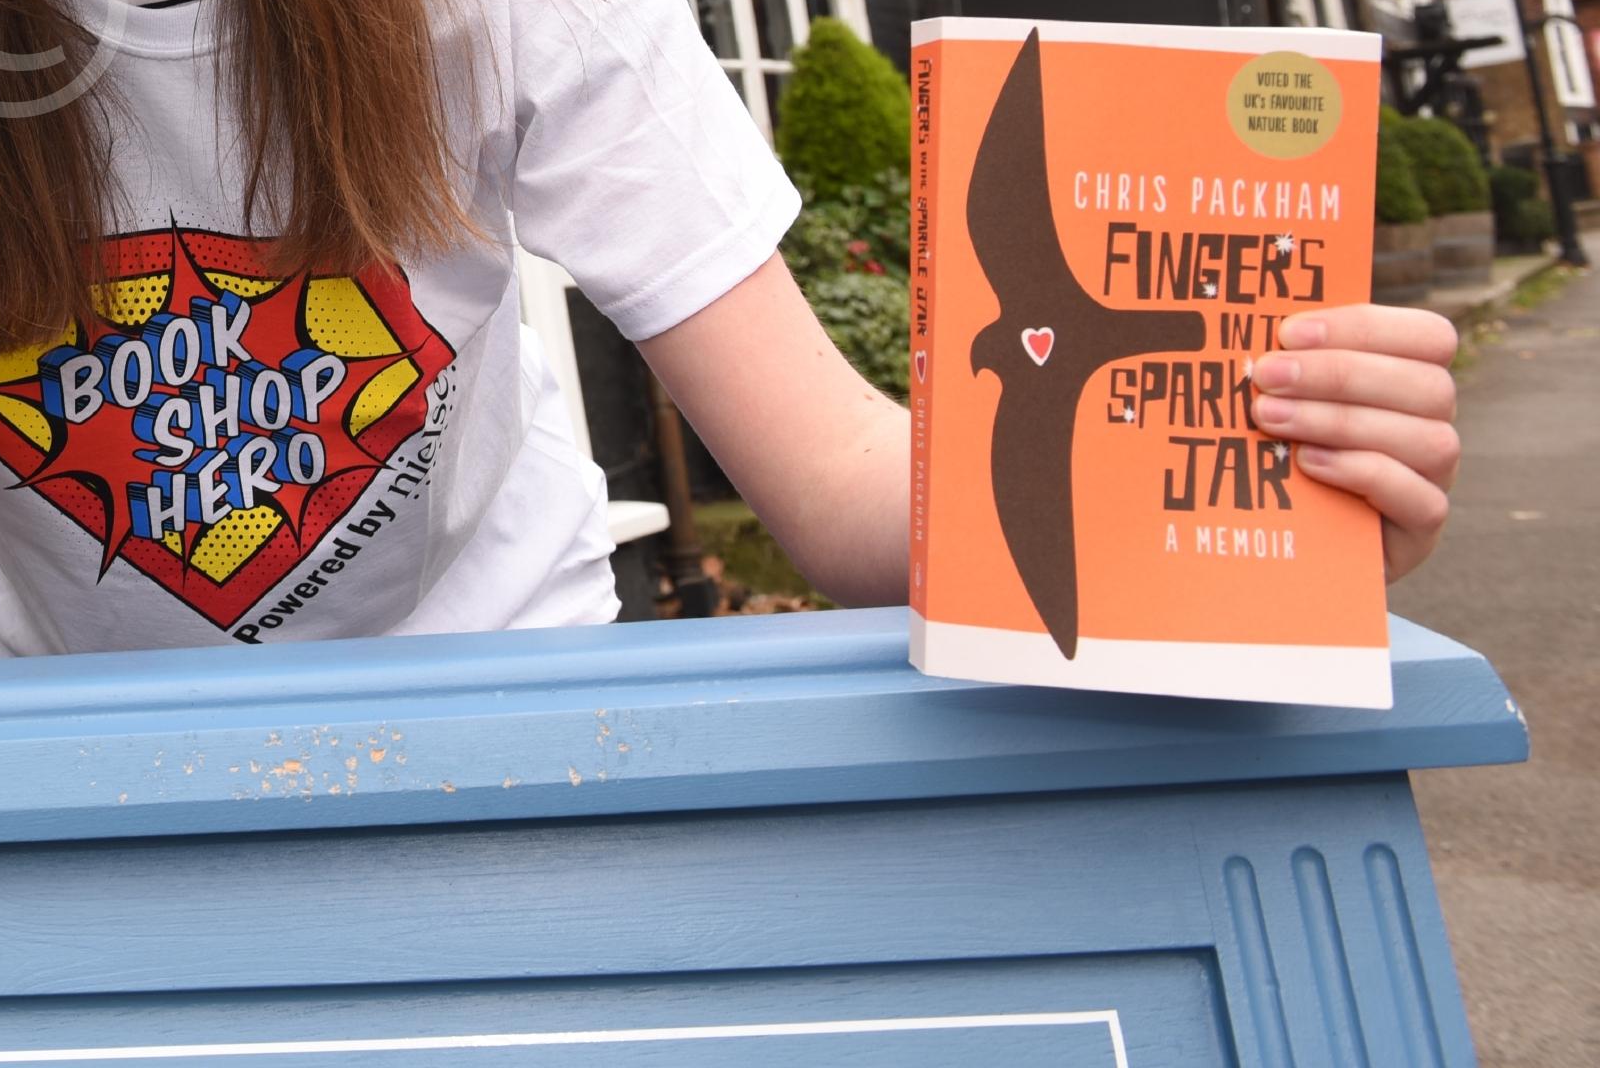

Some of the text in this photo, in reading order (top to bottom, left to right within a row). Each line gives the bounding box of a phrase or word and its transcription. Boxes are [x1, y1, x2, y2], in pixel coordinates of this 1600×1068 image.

[918, 58, 932, 145] FINGERS
[1244, 92, 1325, 112] UK's FAVOURITE
[1257, 71, 1314, 89] VOTED THE
[1248, 115, 1319, 134] NATURE BOOK
[1074, 170, 1341, 221] CHRIS PACKHAM
[917, 196, 930, 278] SPARKLE
[1104, 222, 1324, 304] FINGERS
[916, 286, 927, 337] JAR
[1219, 312, 1254, 351] IN
[58, 297, 252, 424] BOOK
[1107, 359, 1259, 432] SPARK
[152, 353, 347, 467] SHOP
[145, 432, 326, 541] HERO
[232, 367, 449, 645] Powered by nielse
[914, 397, 926, 542] CHRIS PACKHAM
[1164, 437, 1293, 511] JAR
[1164, 524, 1296, 560] A MEMOIR
